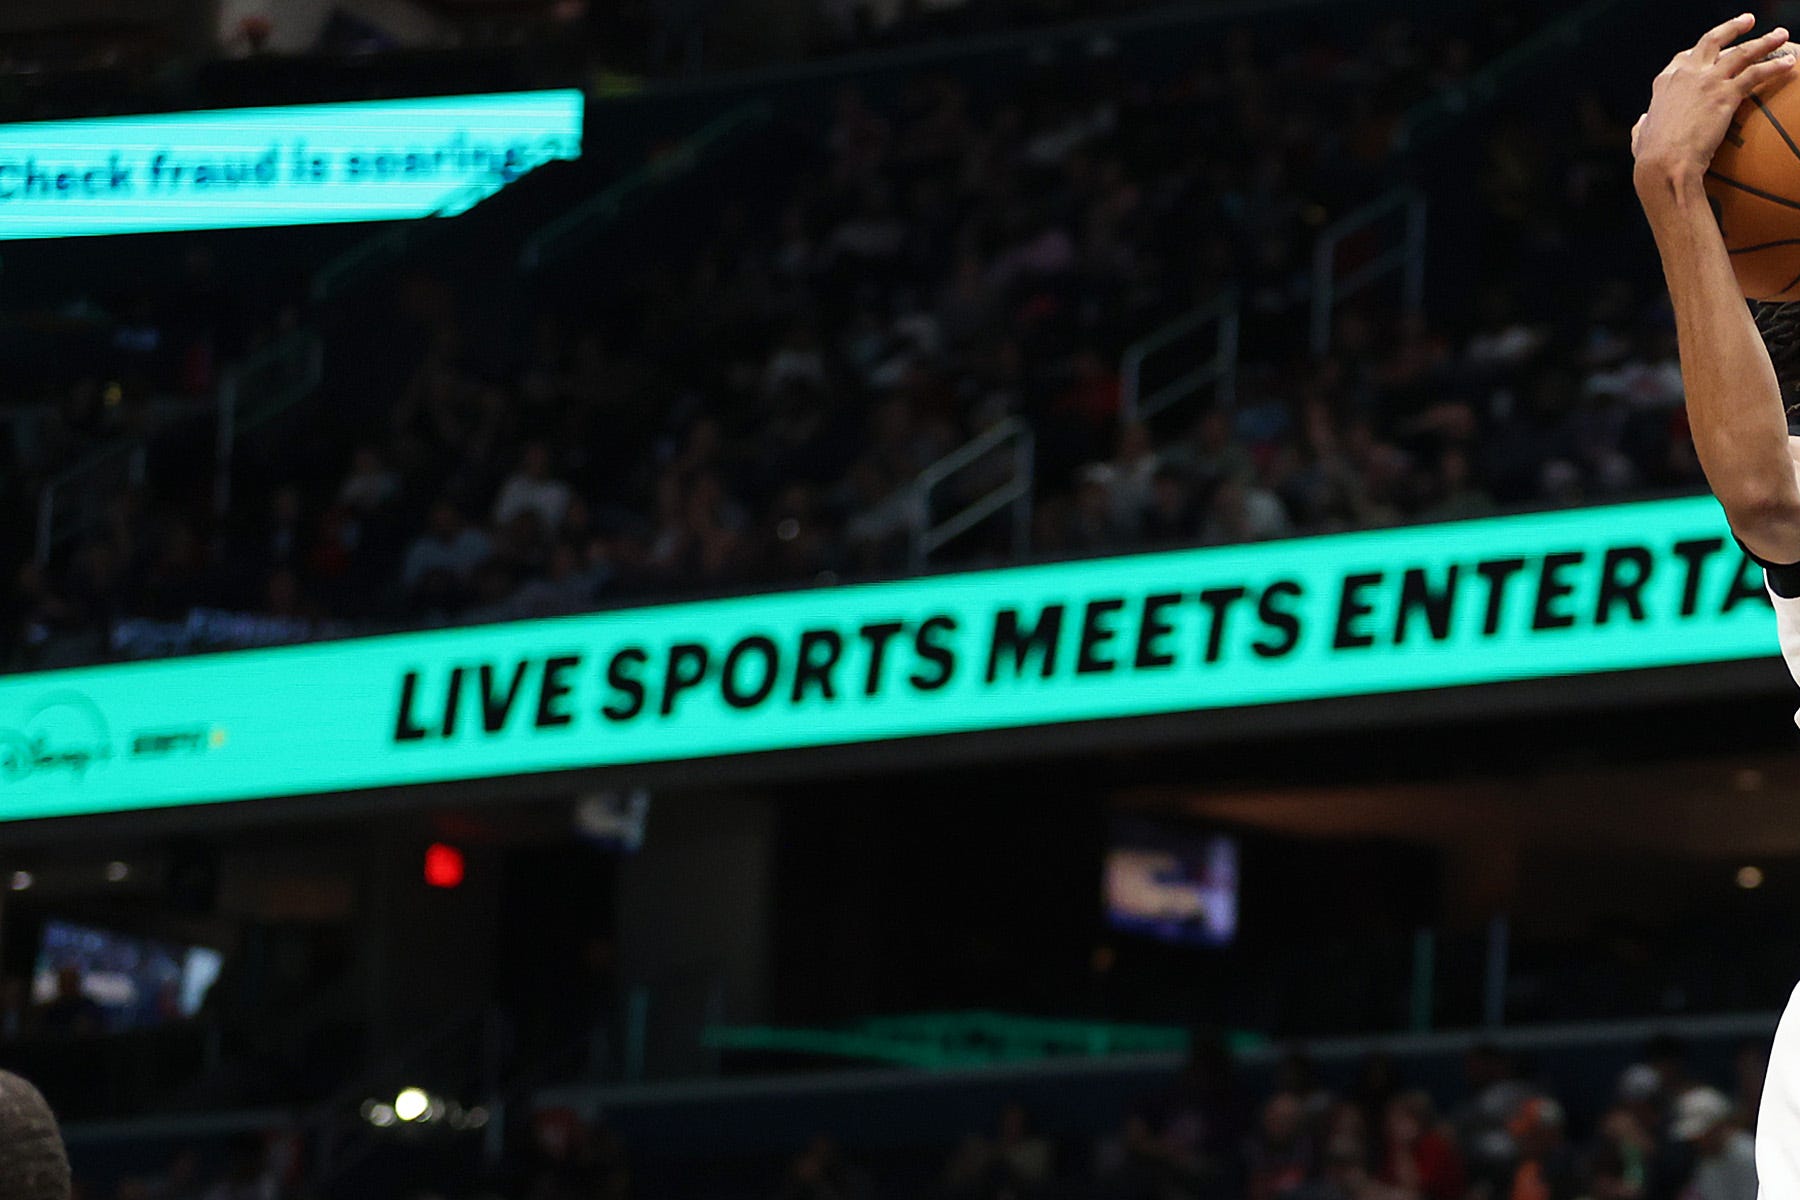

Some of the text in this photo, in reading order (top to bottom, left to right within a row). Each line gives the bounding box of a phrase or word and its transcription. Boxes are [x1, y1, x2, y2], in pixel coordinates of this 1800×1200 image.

[394, 656, 582, 743] LIVE
[600, 615, 959, 723] SPORTS
[984, 580, 1303, 683] MEETS
